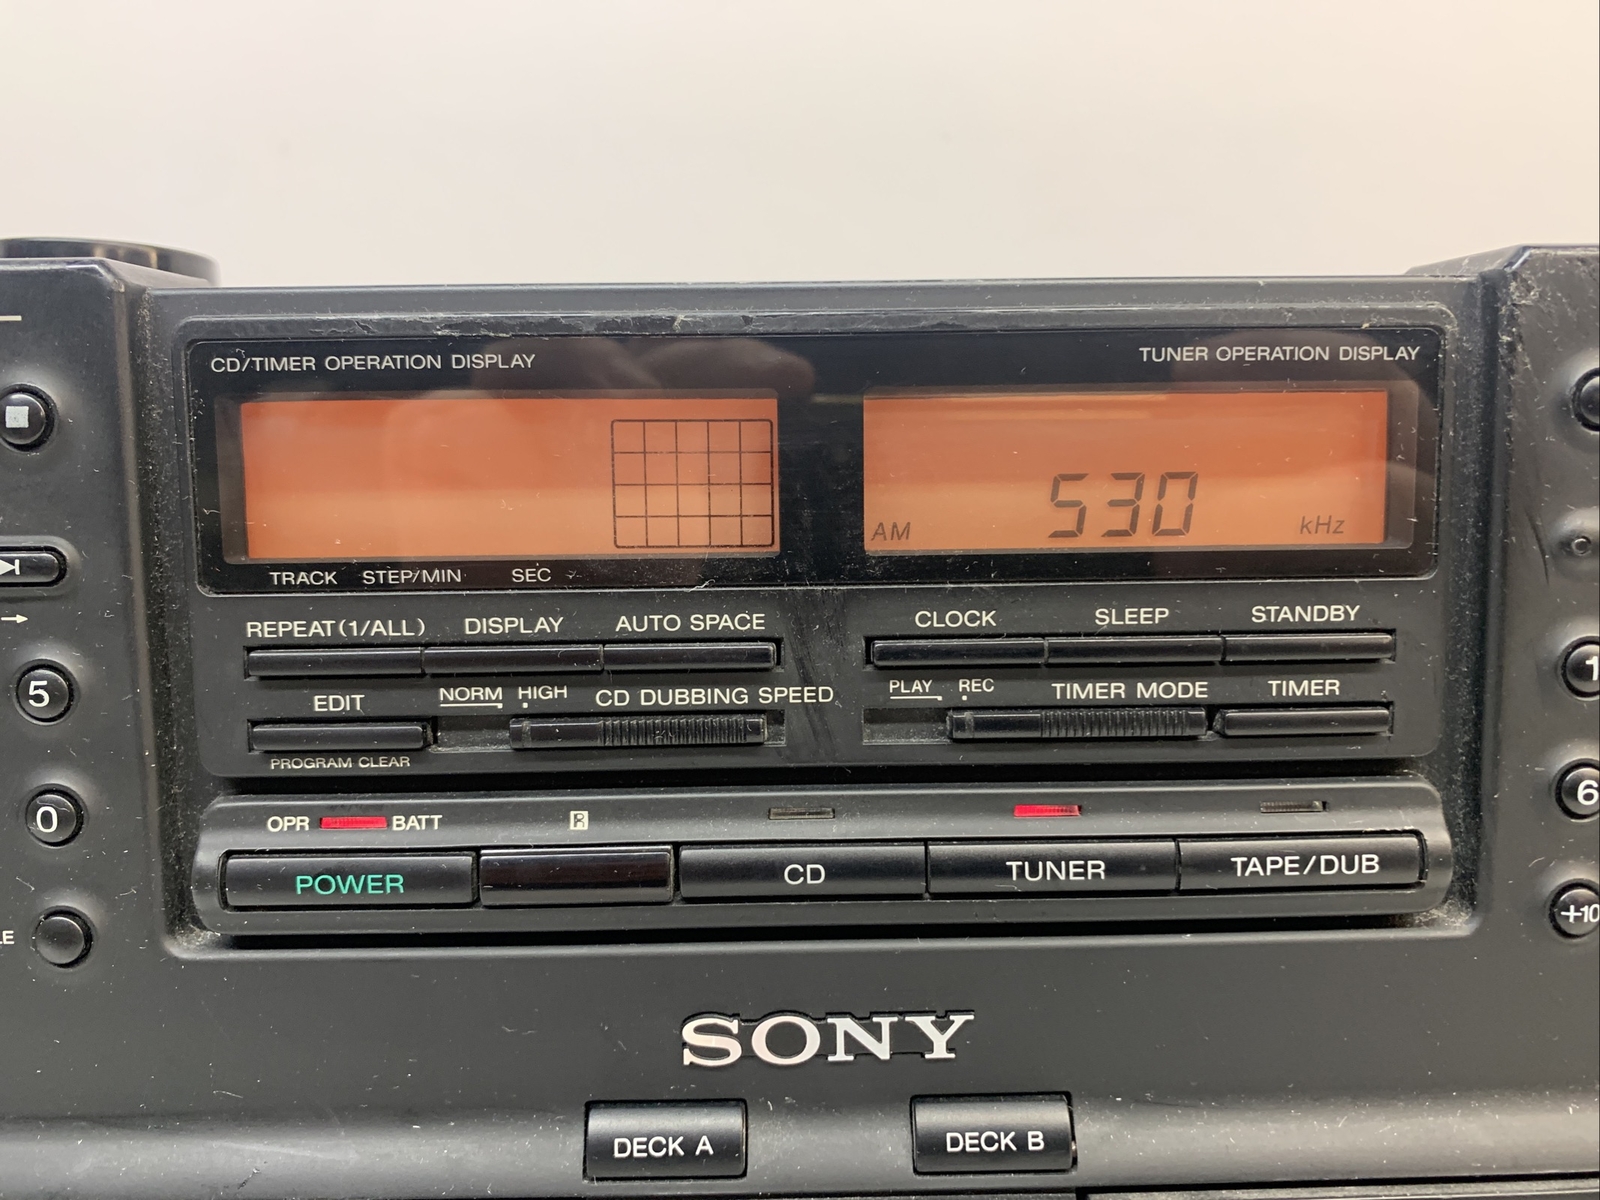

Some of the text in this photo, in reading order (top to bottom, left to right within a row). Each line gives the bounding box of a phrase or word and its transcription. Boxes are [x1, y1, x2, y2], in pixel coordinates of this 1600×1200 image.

[210, 354, 535, 373] CD/TIMER OPERATION DISPLAY
[1139, 346, 1420, 362] TUNER OPERATION DISPLAY
[1048, 471, 1199, 538] 530
[871, 522, 912, 541] AM
[1300, 515, 1345, 535] kHz
[270, 568, 552, 586] TRACK STEP/MIN SEC
[616, 613, 766, 632] AUTO SPACE
[914, 610, 996, 628] CLOCK
[1094, 608, 1169, 625] SLEEP
[1251, 605, 1360, 623] STANDBY
[246, 618, 426, 638] REPEAT(1/ALL)
[464, 617, 564, 635] DISPLAY
[1585, 656, 1599, 681] 1
[28, 681, 50, 706] 5
[439, 686, 568, 702] NORM HIGH
[596, 686, 834, 706] CD DUBBING SPEED
[889, 679, 995, 694] PLAY REC
[1051, 681, 1208, 700] TIMER MODE
[1268, 680, 1340, 696] TIMER
[313, 694, 365, 712] EDIT
[270, 756, 410, 771] PROGRAM CLEAR
[1576, 779, 1599, 805] 6
[35, 806, 59, 833] 0
[266, 815, 442, 832] OPR BATT
[784, 864, 826, 885] CD
[1006, 860, 1106, 880] TUNER
[1230, 854, 1380, 877] TAPE/DUB
[296, 874, 405, 895] POWER
[1560, 904, 1599, 924] +10
[682, 1014, 975, 1065] SONY
[613, 1135, 714, 1158] DECK A
[946, 1130, 1045, 1152] DECK B
